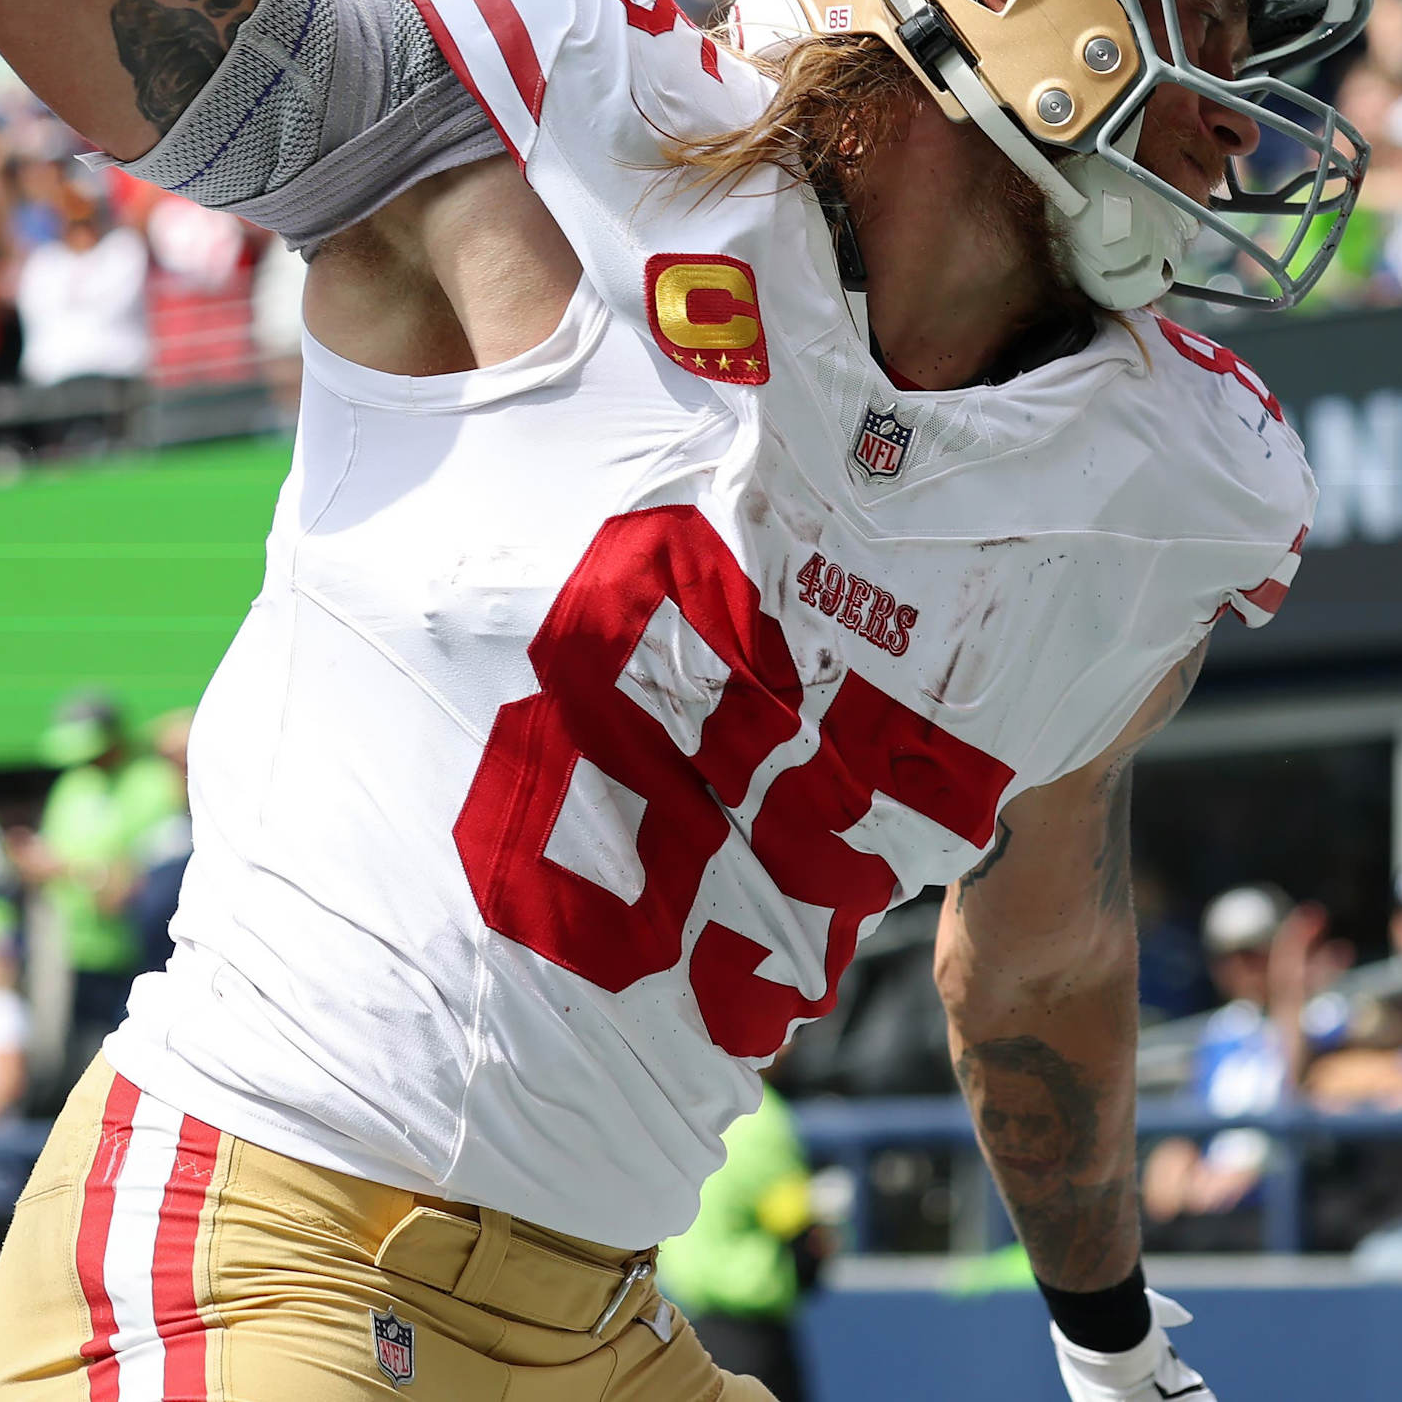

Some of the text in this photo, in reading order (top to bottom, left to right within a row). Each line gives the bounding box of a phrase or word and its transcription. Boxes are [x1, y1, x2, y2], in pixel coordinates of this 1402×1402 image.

[829, 8, 850, 30] 85
[656, 264, 759, 350] C
[858, 432, 897, 471] NFL
[797, 552, 918, 657] 49ERS
[451, 504, 1017, 1058] 85
[378, 1338, 410, 1371] NFL
